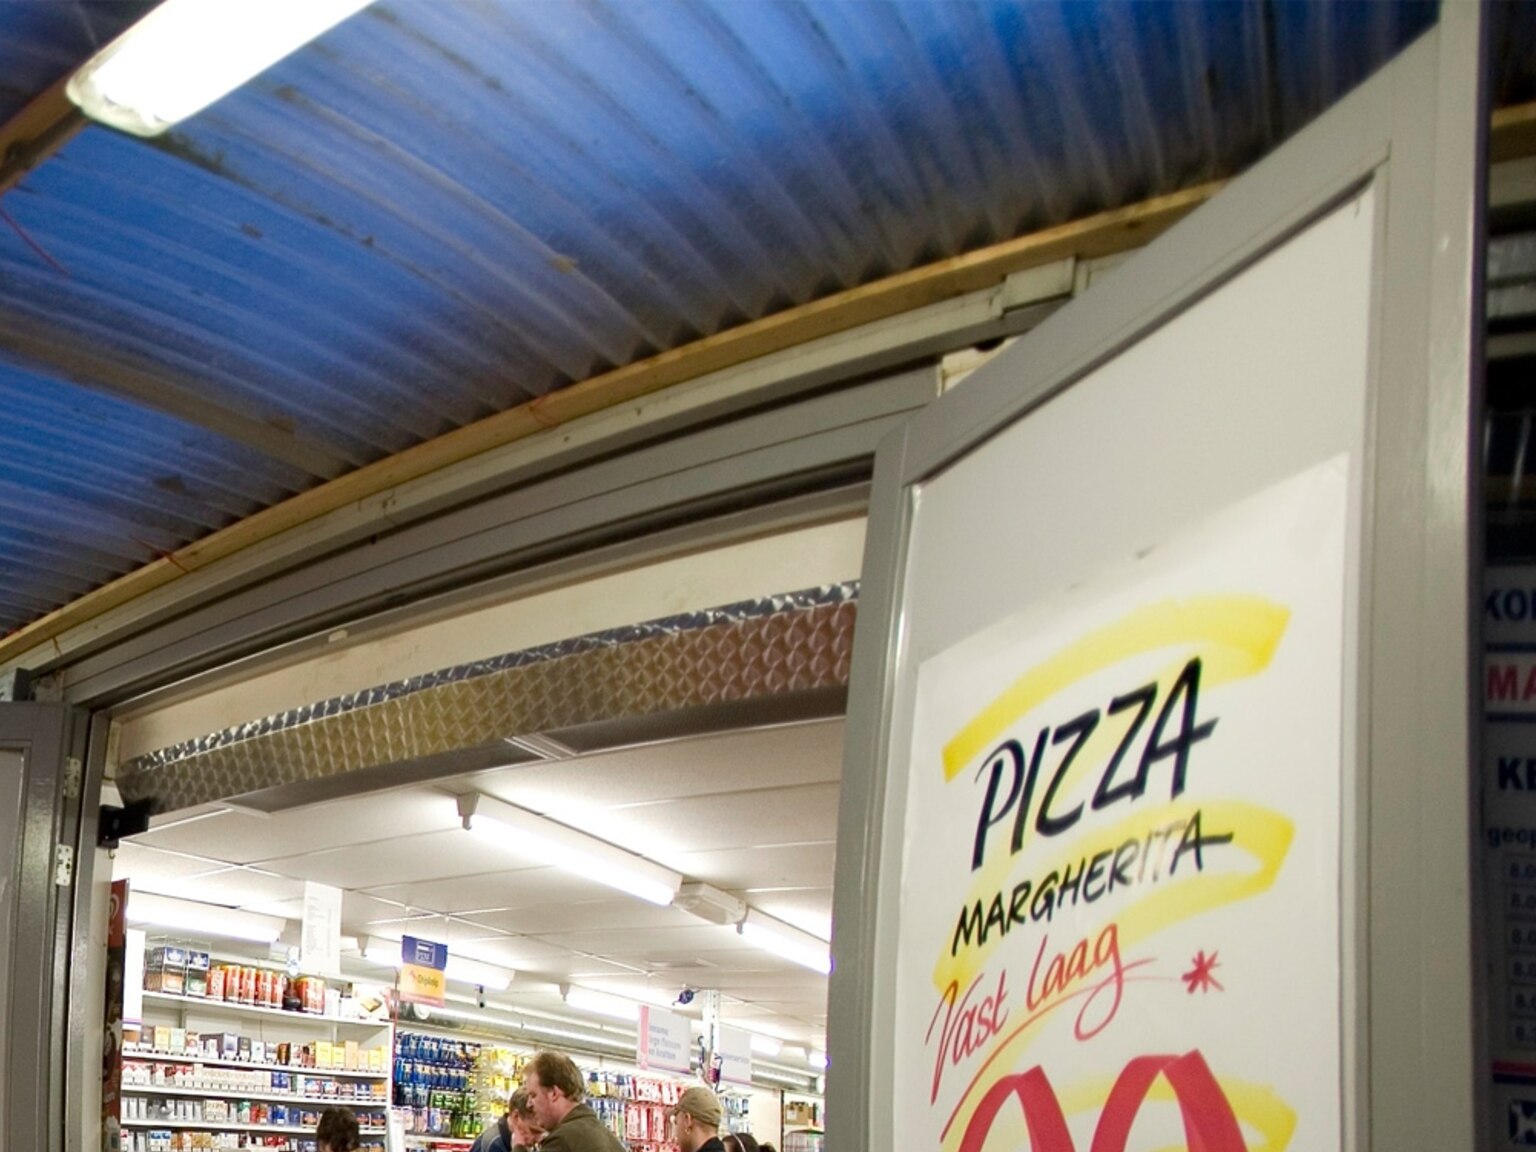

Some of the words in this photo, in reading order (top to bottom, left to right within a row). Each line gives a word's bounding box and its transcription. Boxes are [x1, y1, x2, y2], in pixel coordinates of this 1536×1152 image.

[970, 655, 1220, 873] PIZZA
[951, 809, 1234, 957] MARGHERITA
[925, 970, 1009, 1106] Vast
